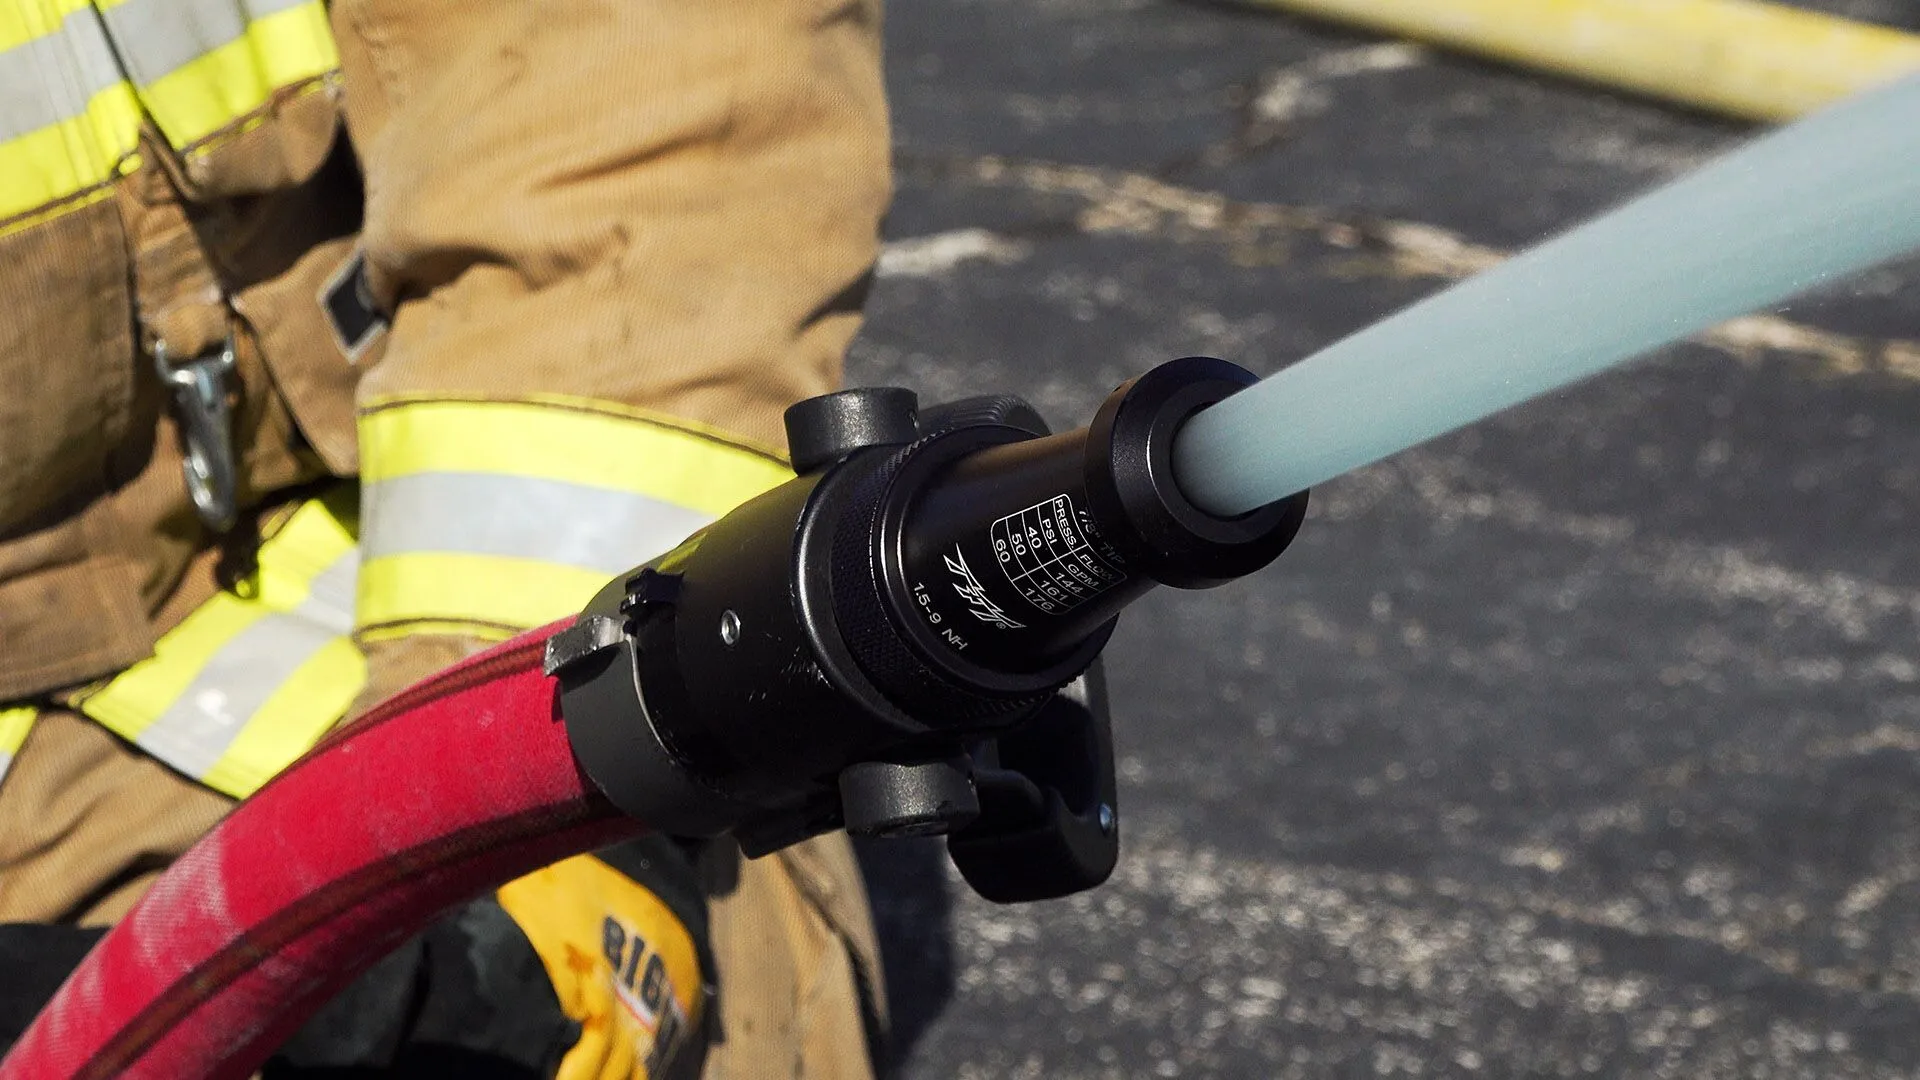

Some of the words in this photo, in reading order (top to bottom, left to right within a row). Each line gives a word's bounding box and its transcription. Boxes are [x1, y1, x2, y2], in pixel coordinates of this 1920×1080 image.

[1042, 518, 1058, 545] PSI
[1067, 563, 1100, 588] GPM
[1055, 498, 1077, 549] PRESS.
[995, 538, 1011, 563] 60
[1025, 587, 1056, 611] 176
[1011, 533, 1027, 556] 50
[1040, 580, 1069, 601] 161
[1028, 526, 1042, 549] 40
[1055, 572, 1084, 593] 144
[914, 582, 942, 624] 1.5-9
[941, 628, 969, 650] NH
